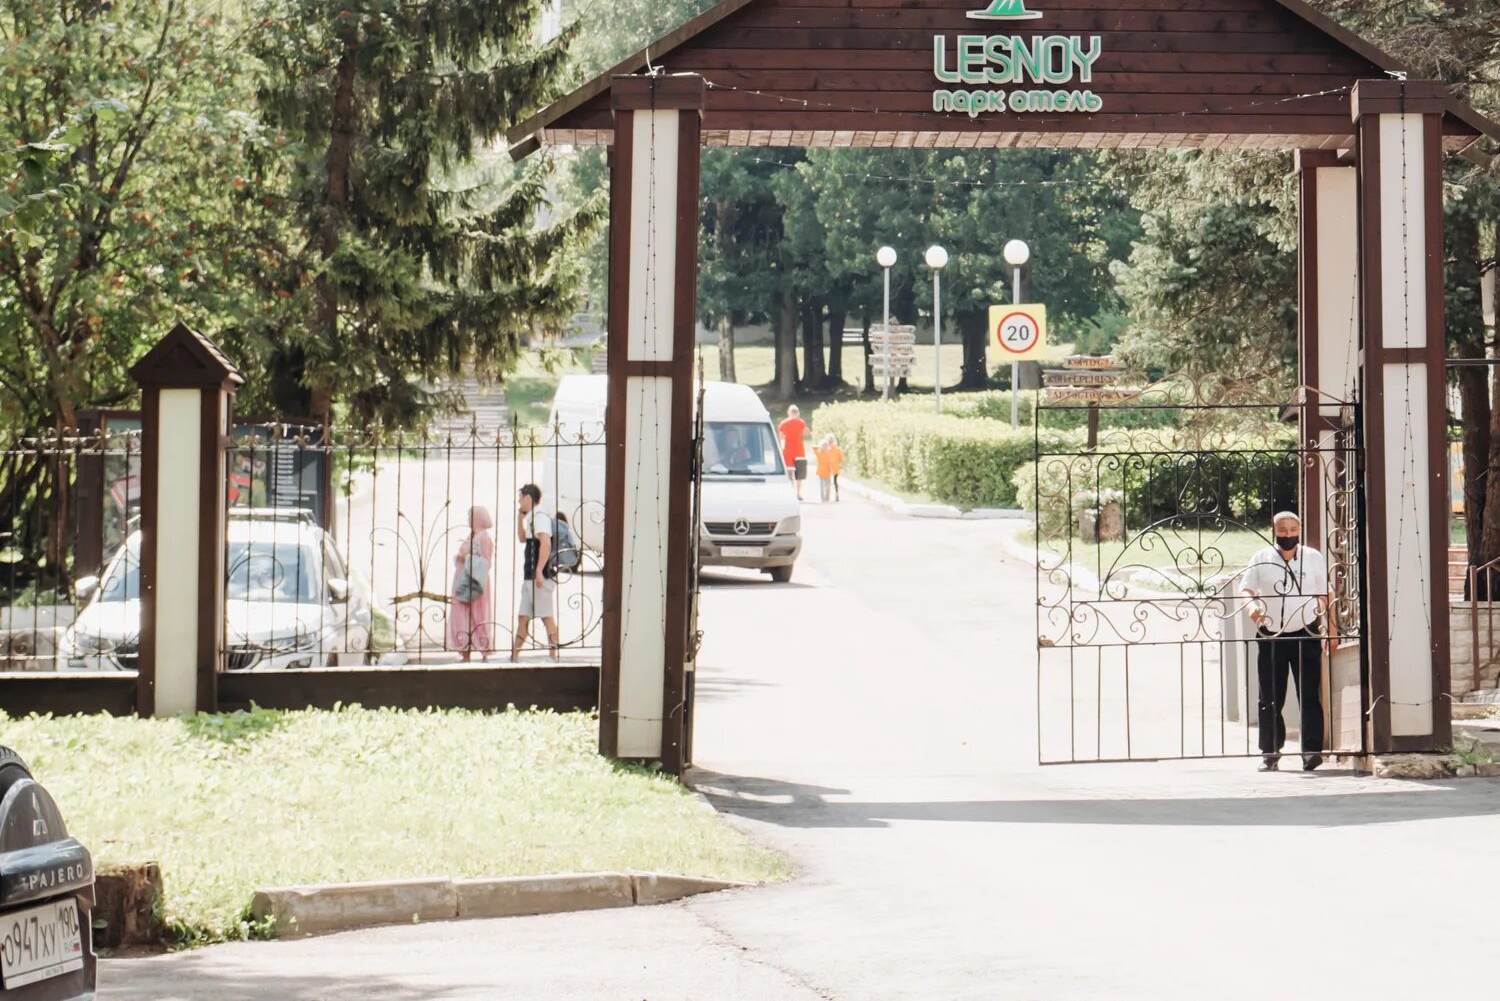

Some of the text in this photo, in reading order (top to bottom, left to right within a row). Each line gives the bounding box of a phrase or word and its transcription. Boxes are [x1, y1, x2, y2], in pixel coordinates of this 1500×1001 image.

[934, 35, 1101, 84] LESNOY
[933, 90, 1103, 118] парк отель
[1007, 325, 1029, 341] 20
[28, 863, 83, 890] PAJERO
[58, 904, 78, 940] 190
